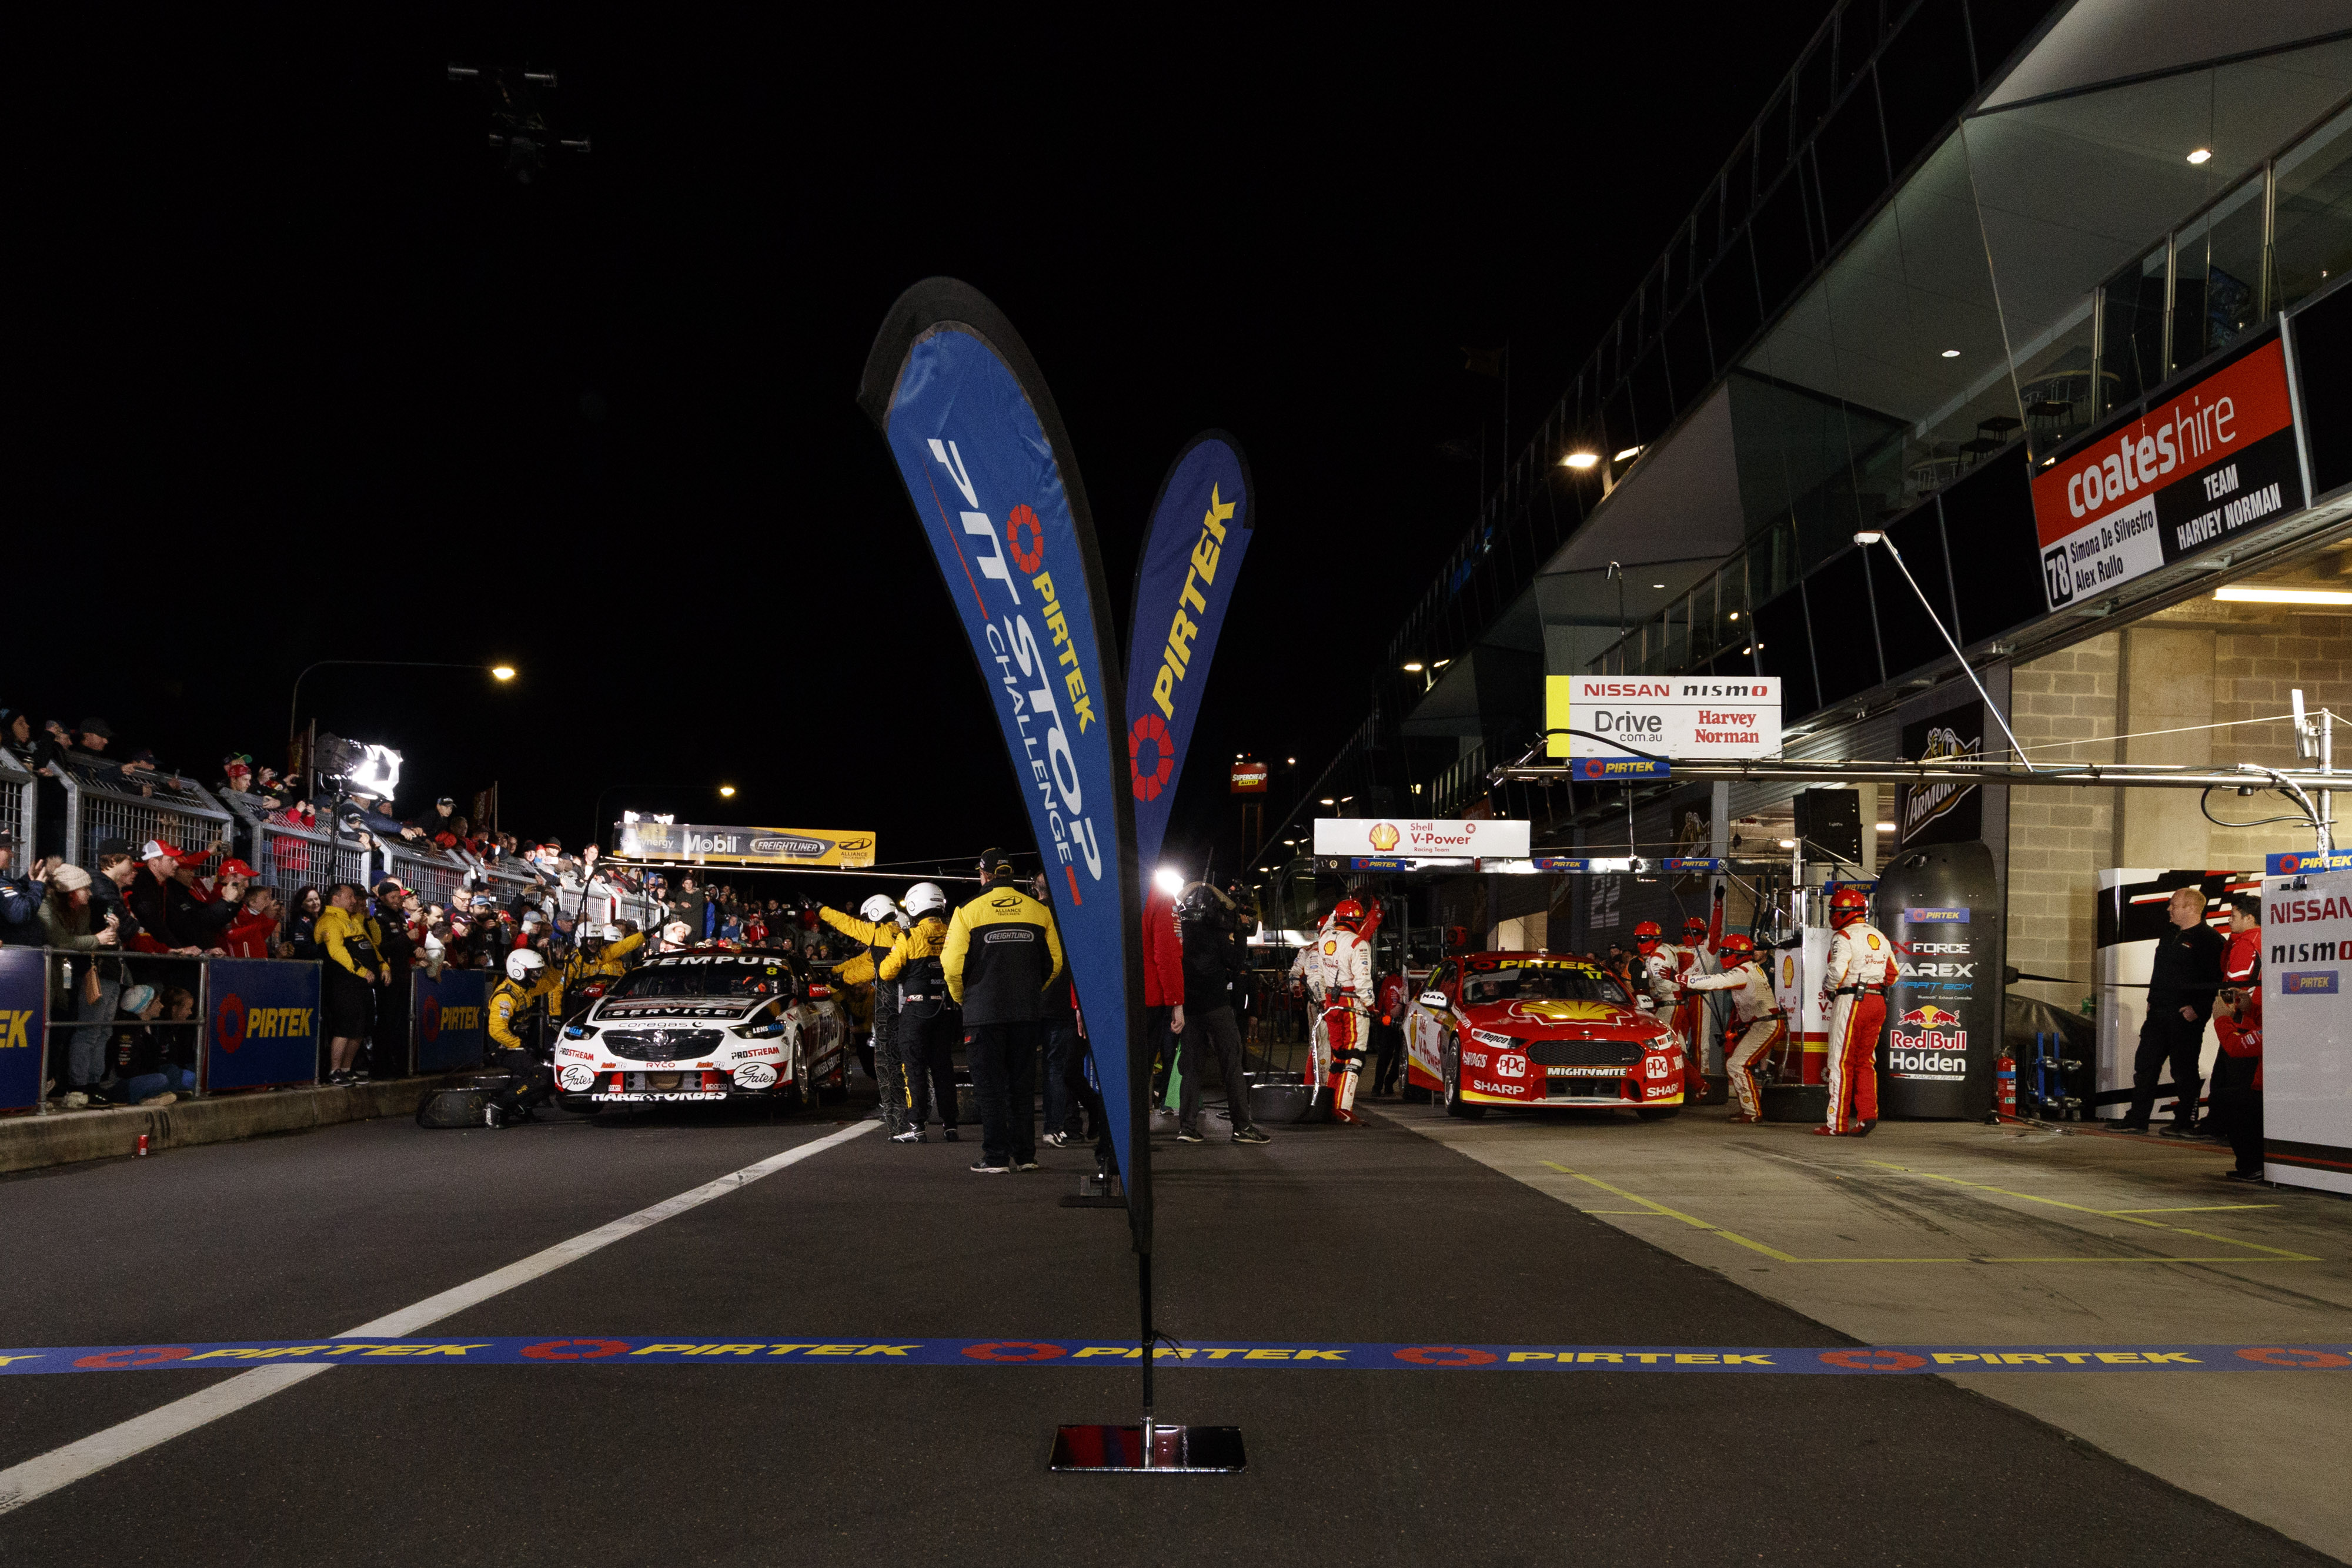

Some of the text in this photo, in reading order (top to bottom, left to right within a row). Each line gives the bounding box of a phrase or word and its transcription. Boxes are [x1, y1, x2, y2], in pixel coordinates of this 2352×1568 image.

[2204, 464, 2239, 502] TEAM
[2176, 483, 2282, 550] HARVEY NORMAN
[2070, 510, 2153, 564] Simona De Silvestro
[2046, 554, 2070, 600] 78
[2076, 554, 2123, 592] Alex Rullo
[1152, 482, 1236, 721] PIRTEK
[927, 439, 1101, 881] PIT STOP
[1033, 571, 1096, 734] PIRTEK
[1585, 684, 1768, 696] NISSAN nismo
[1595, 710, 1662, 733] Drive
[1698, 710, 1756, 728] Harvey
[1620, 733, 1662, 742] com.au
[1695, 728, 1759, 743] Norman
[985, 623, 1071, 864] CHALLENGE
[1605, 761, 1655, 773] PIRTEK
[1232, 773, 1267, 781] SUPERCHEAP
[1410, 823, 1433, 831] Shell
[684, 834, 737, 853] Mobil
[757, 840, 818, 852] FREIGHTLINER
[1411, 833, 1471, 844] V-Power
[2271, 896, 2352, 924] NISSAN
[2271, 941, 2352, 964] nismo
[643, 957, 783, 967] TEMPUR
[1499, 960, 1596, 970] PIRTEK
[1583, 971, 1602, 979] 17
[2300, 977, 2329, 988] PIRTEK
[1892, 981, 1973, 994] MART BOX
[246, 1008, 313, 1038] PIRTEK
[440, 1007, 480, 1031] PIRTEK
[1482, 1032, 1508, 1044] Repco
[1890, 1030, 1967, 1050] Red Bull
[559, 1048, 594, 1061] PROSTREAM
[731, 1047, 780, 1059] PROSTREAM
[1889, 1051, 1966, 1072] Holden
[561, 1068, 594, 1086] Gates
[734, 1065, 777, 1086] Gates
[1474, 1080, 1525, 1095] SHARP
[1647, 1082, 1679, 1097] SHARP
[184, 1344, 493, 1360] PIRTEK
[630, 1344, 924, 1356] PIRTEK
[1072, 1347, 1351, 1360] PIRTEK
[1507, 1352, 1777, 1365] PIRTEK
[1931, 1352, 2204, 1364] PIRTEK
